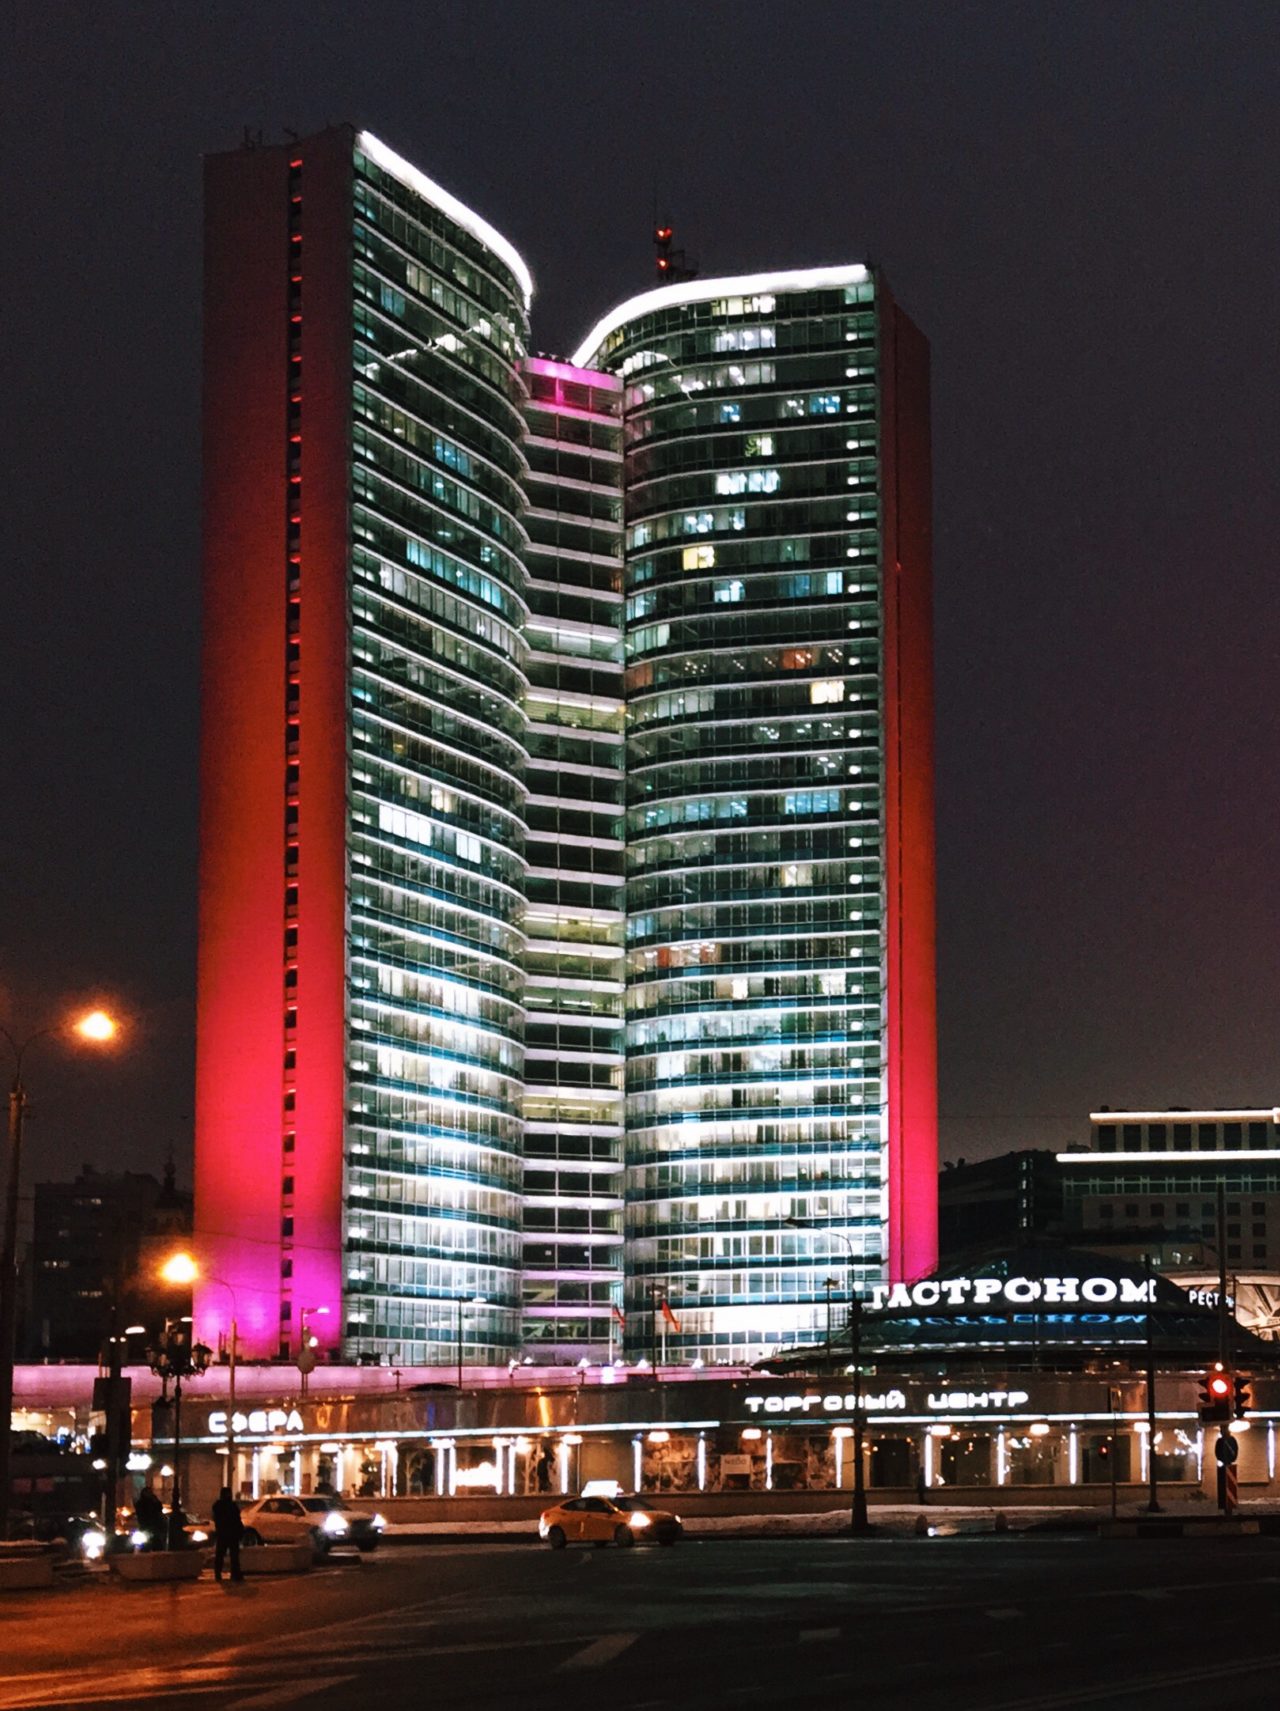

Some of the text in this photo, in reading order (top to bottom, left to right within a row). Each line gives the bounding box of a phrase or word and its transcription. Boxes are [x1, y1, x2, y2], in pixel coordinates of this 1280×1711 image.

[871, 1277, 1157, 1310] ГАСТРОНОМ
[927, 1391, 1029, 1410] ЦЕНТР
[208, 1409, 304, 1434] СФЕРА
